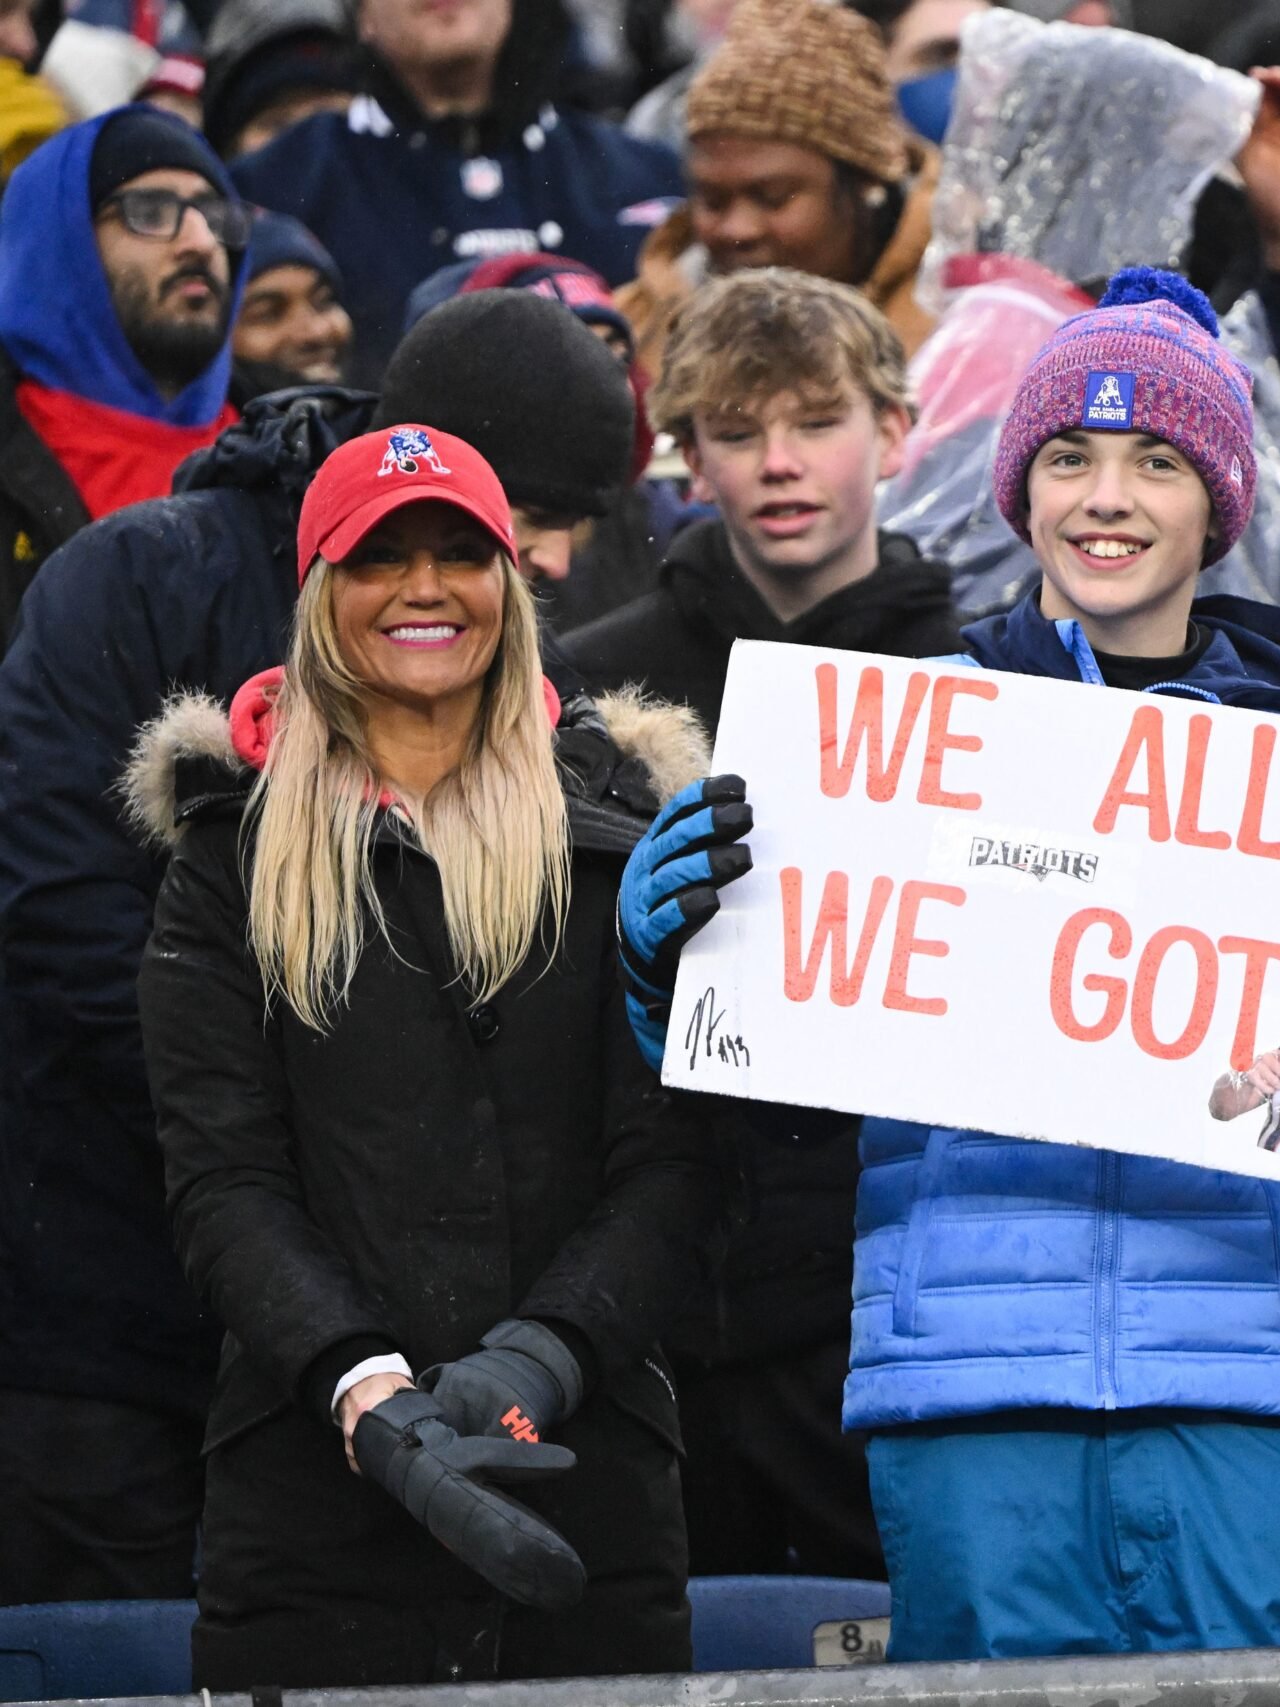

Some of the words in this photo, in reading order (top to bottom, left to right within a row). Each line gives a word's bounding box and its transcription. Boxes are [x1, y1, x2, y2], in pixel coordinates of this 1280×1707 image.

[1088, 410, 1127, 421] PATRIOTS
[815, 663, 999, 811] WE
[968, 836, 1099, 883] PATRIOTS
[779, 866, 967, 1016] WE
[841, 1623, 862, 1653] 8
